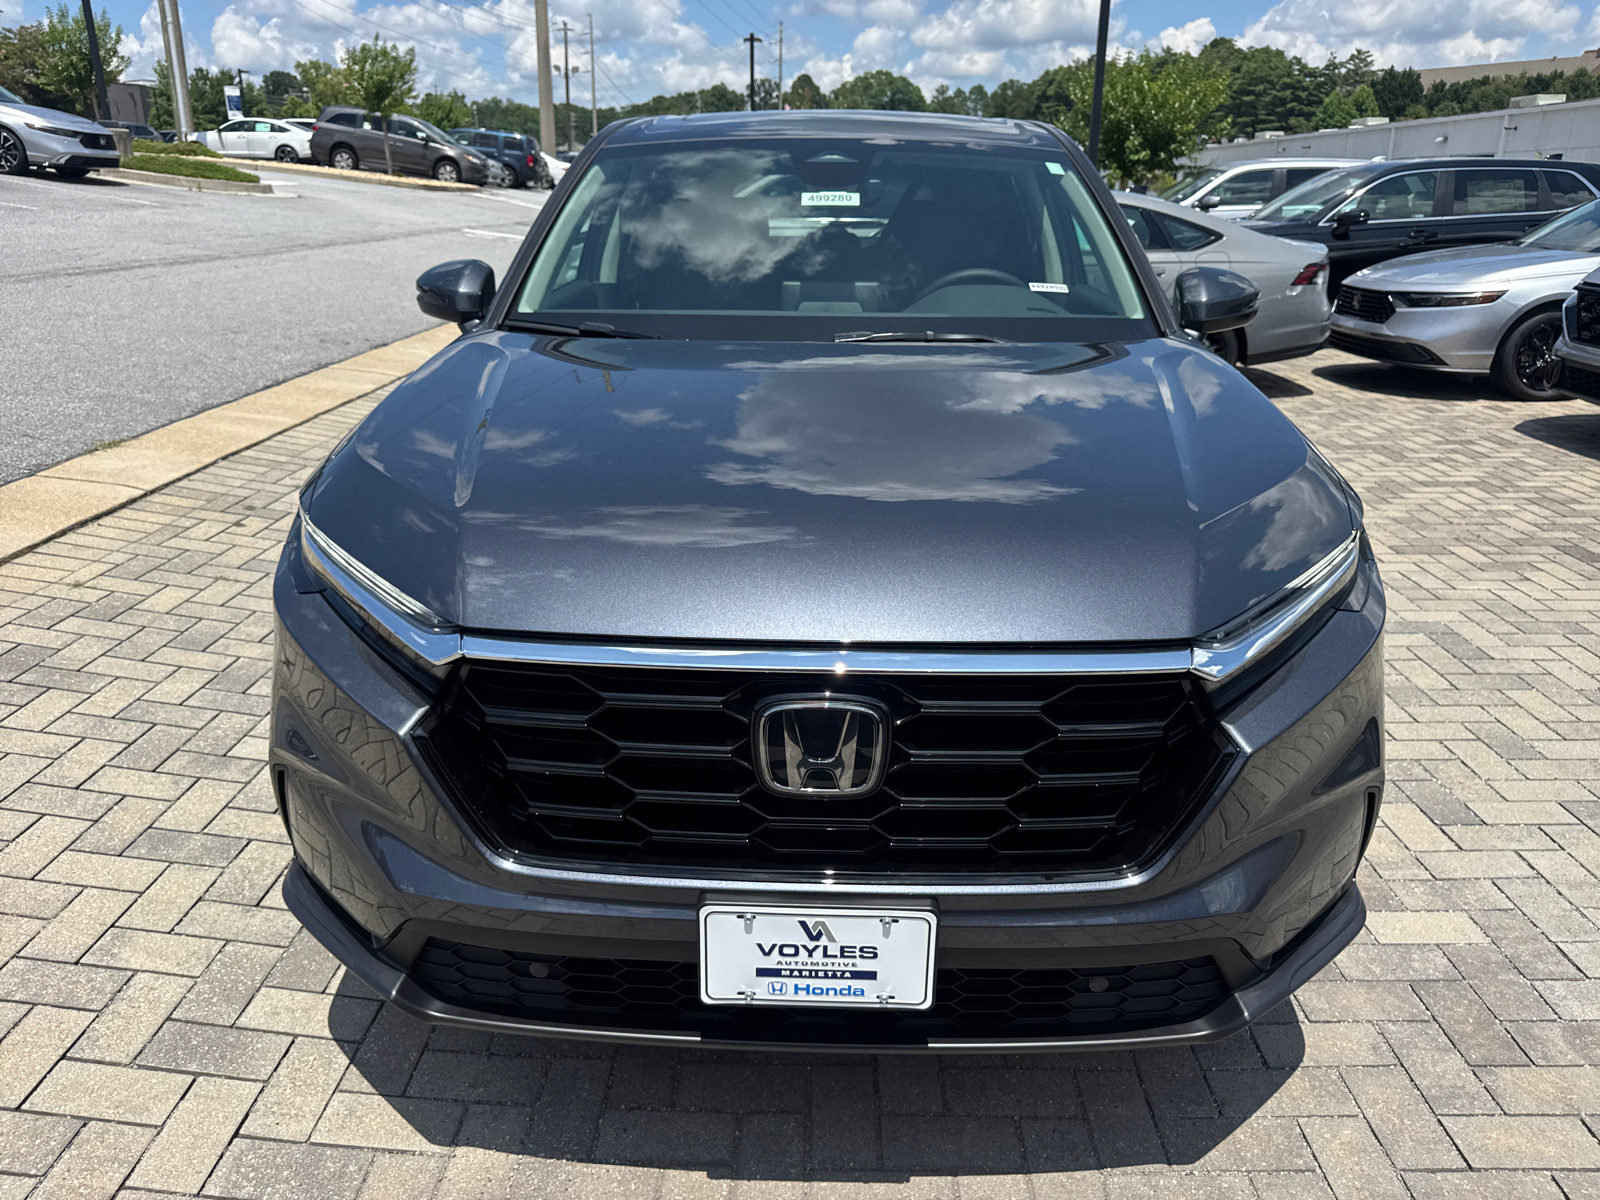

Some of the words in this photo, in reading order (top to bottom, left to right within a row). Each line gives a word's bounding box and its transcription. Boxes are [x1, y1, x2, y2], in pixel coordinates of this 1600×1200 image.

[756, 943, 879, 959] VOYLES
[781, 970, 852, 978] MARIETTA
[793, 983, 865, 996] Honda
